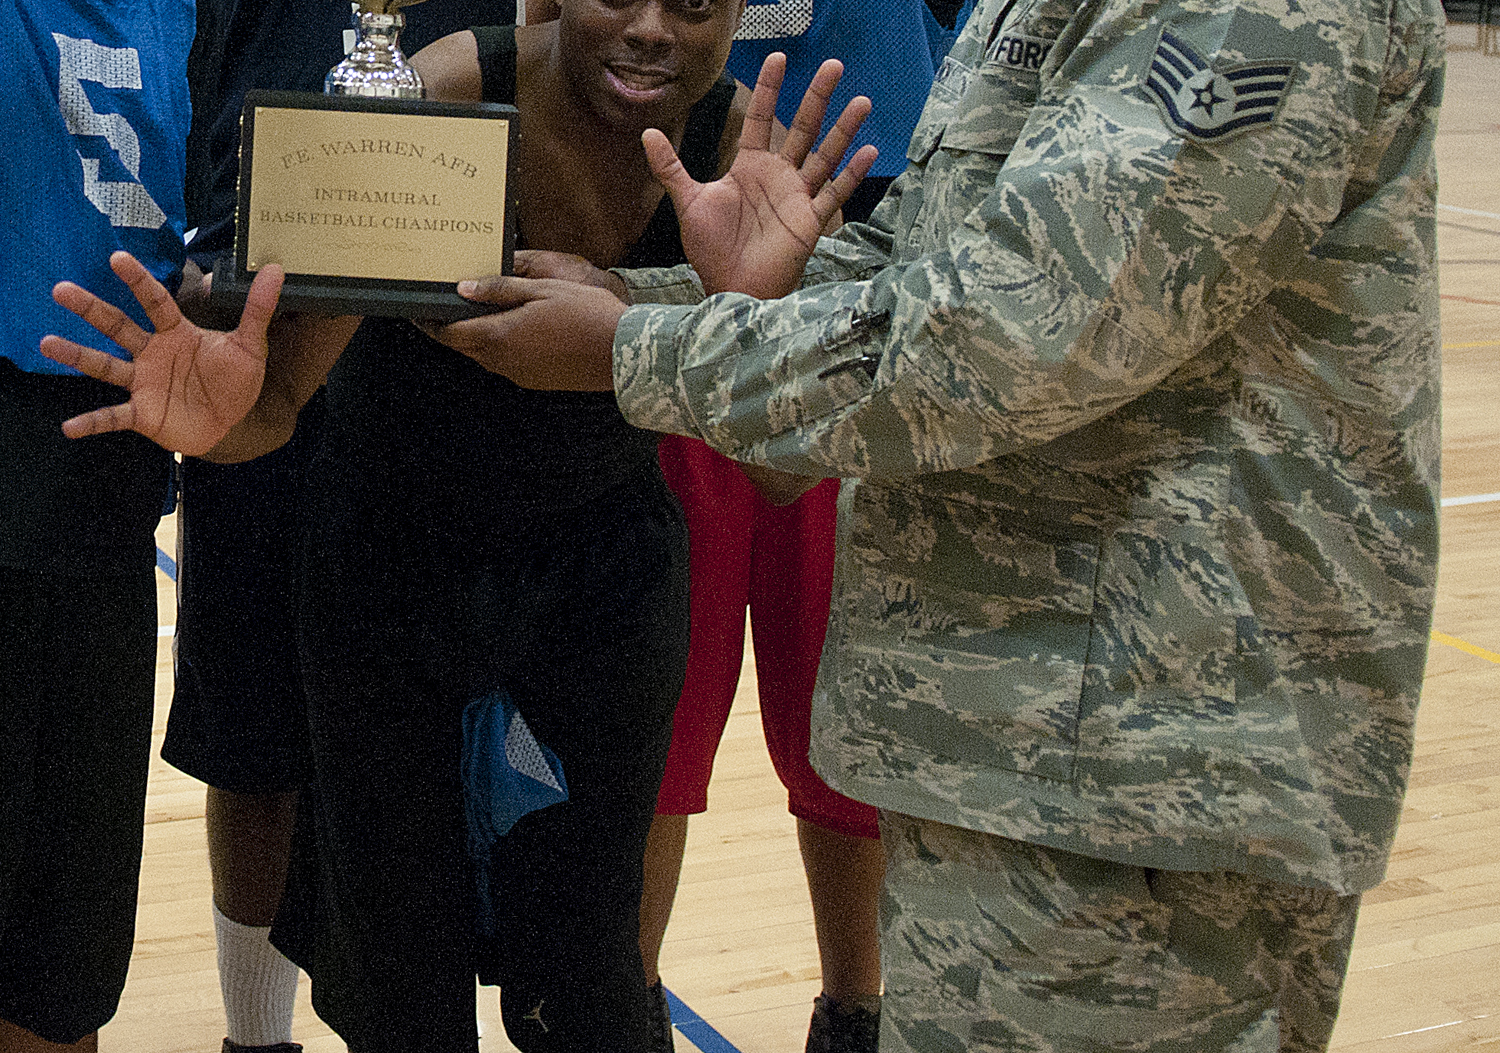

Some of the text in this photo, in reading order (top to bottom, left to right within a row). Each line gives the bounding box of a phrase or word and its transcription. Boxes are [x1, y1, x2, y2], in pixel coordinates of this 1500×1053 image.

[51, 32, 167, 229] 5
[321, 139, 426, 159] WARREN
[431, 152, 478, 179] AFB
[315, 188, 441, 207] INTRAMURAL
[260, 210, 494, 234] BASKETBALL CHAMPIONS
